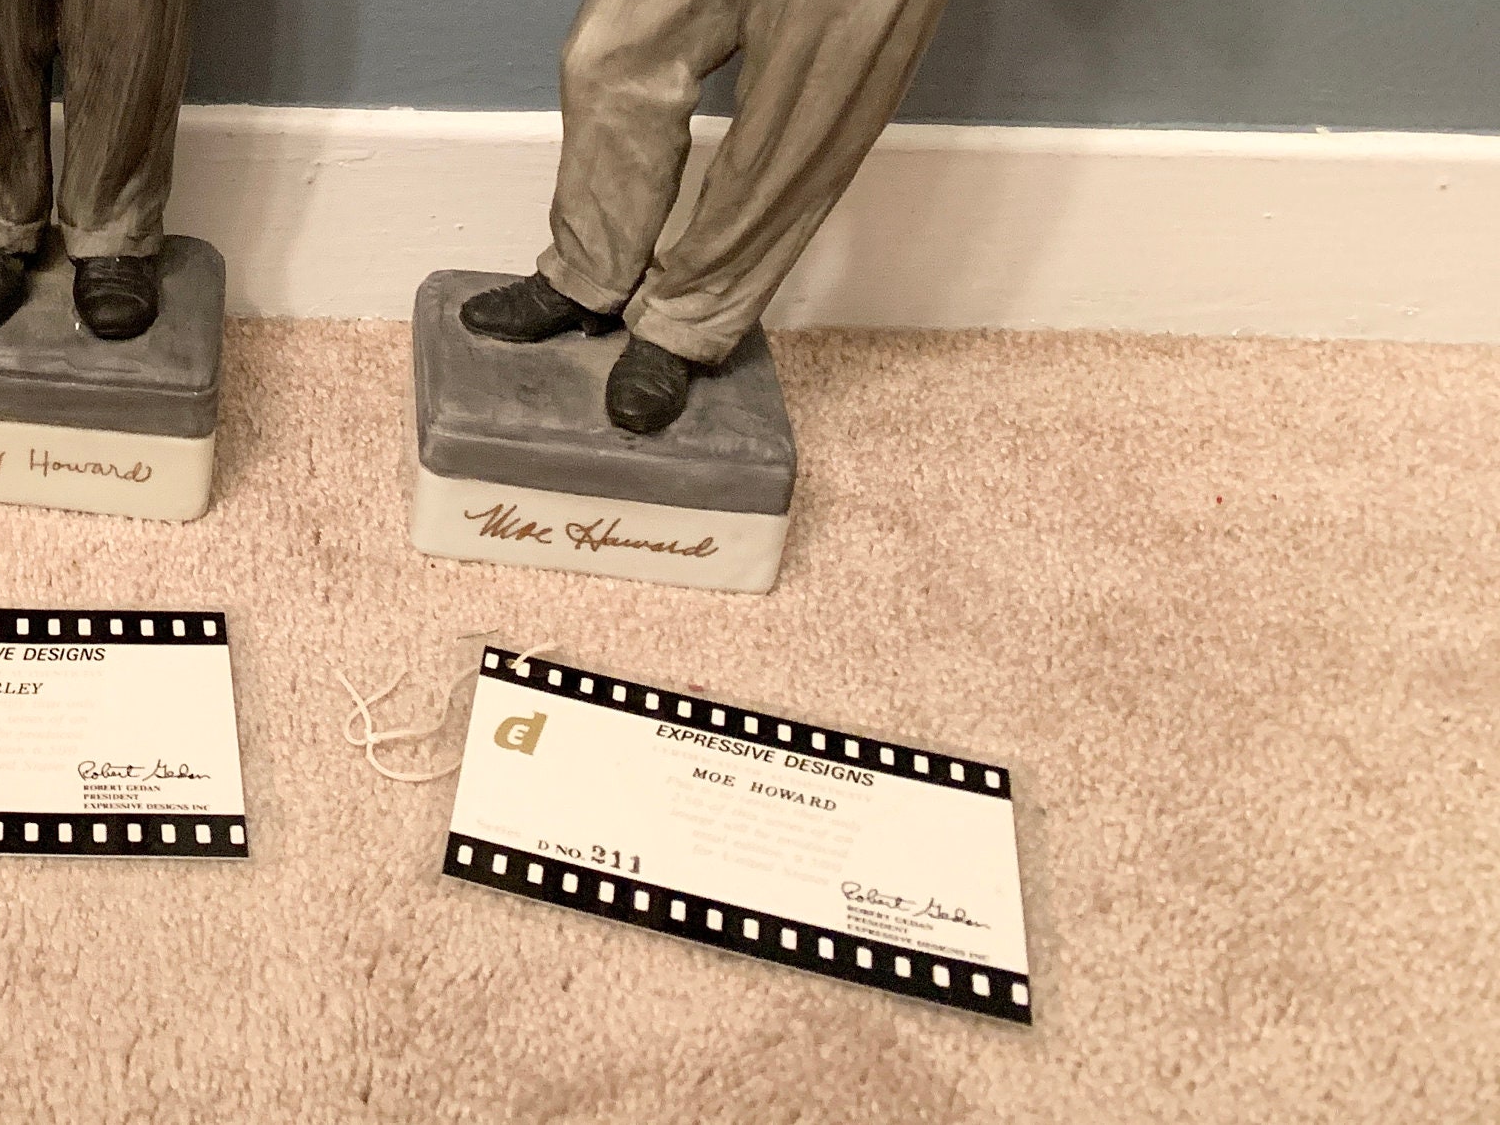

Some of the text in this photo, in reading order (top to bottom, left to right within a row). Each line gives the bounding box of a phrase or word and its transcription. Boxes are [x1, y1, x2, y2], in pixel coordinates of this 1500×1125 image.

[29, 448, 153, 483] Howard
[565, 518, 719, 558] Howard
[22, 646, 107, 663] DESIGNS
[655, 724, 876, 787] EXPRESSIVE DESIGNS
[83, 784, 161, 792] ROBERT GEDAN
[83, 793, 140, 801] PRESIDENT
[691, 767, 838, 812] MOE HOWARD
[83, 802, 211, 812] EXPRESSIVE DESIGNS INC
[537, 839, 641, 875] D NO. 211
